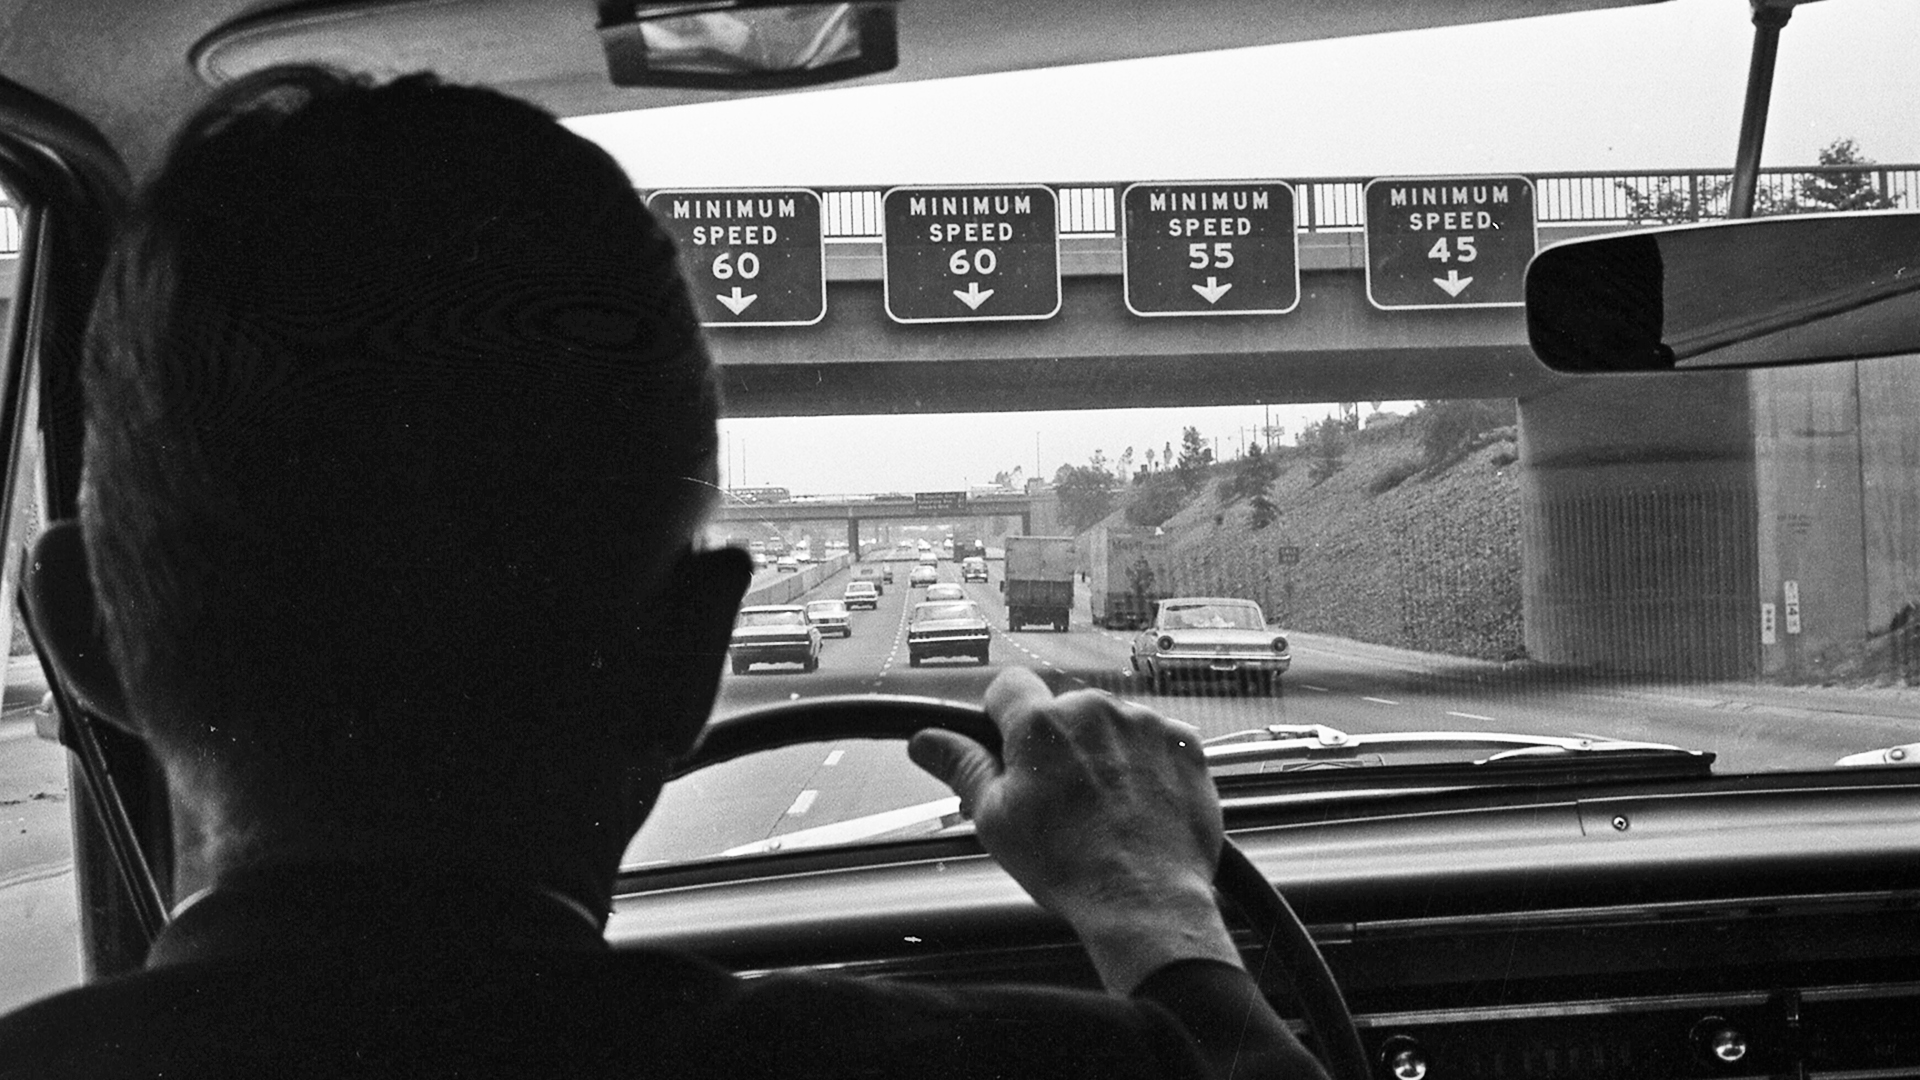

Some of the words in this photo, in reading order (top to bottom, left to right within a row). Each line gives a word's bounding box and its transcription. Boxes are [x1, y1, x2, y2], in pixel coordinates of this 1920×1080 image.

[910, 195, 1031, 216] MINIMUM
[1150, 191, 1268, 211] MINIMUM
[1390, 185, 1509, 206] MINIMUM
[673, 199, 795, 219] MINIMUM
[1168, 217, 1251, 237] SPEED
[1409, 211, 1491, 231] SPEED
[692, 225, 777, 245] SPEED
[929, 223, 1013, 242] SPEED
[1189, 242, 1235, 270] 55
[1427, 236, 1478, 263] 45
[712, 252, 760, 280] 60
[949, 248, 997, 275] 60
